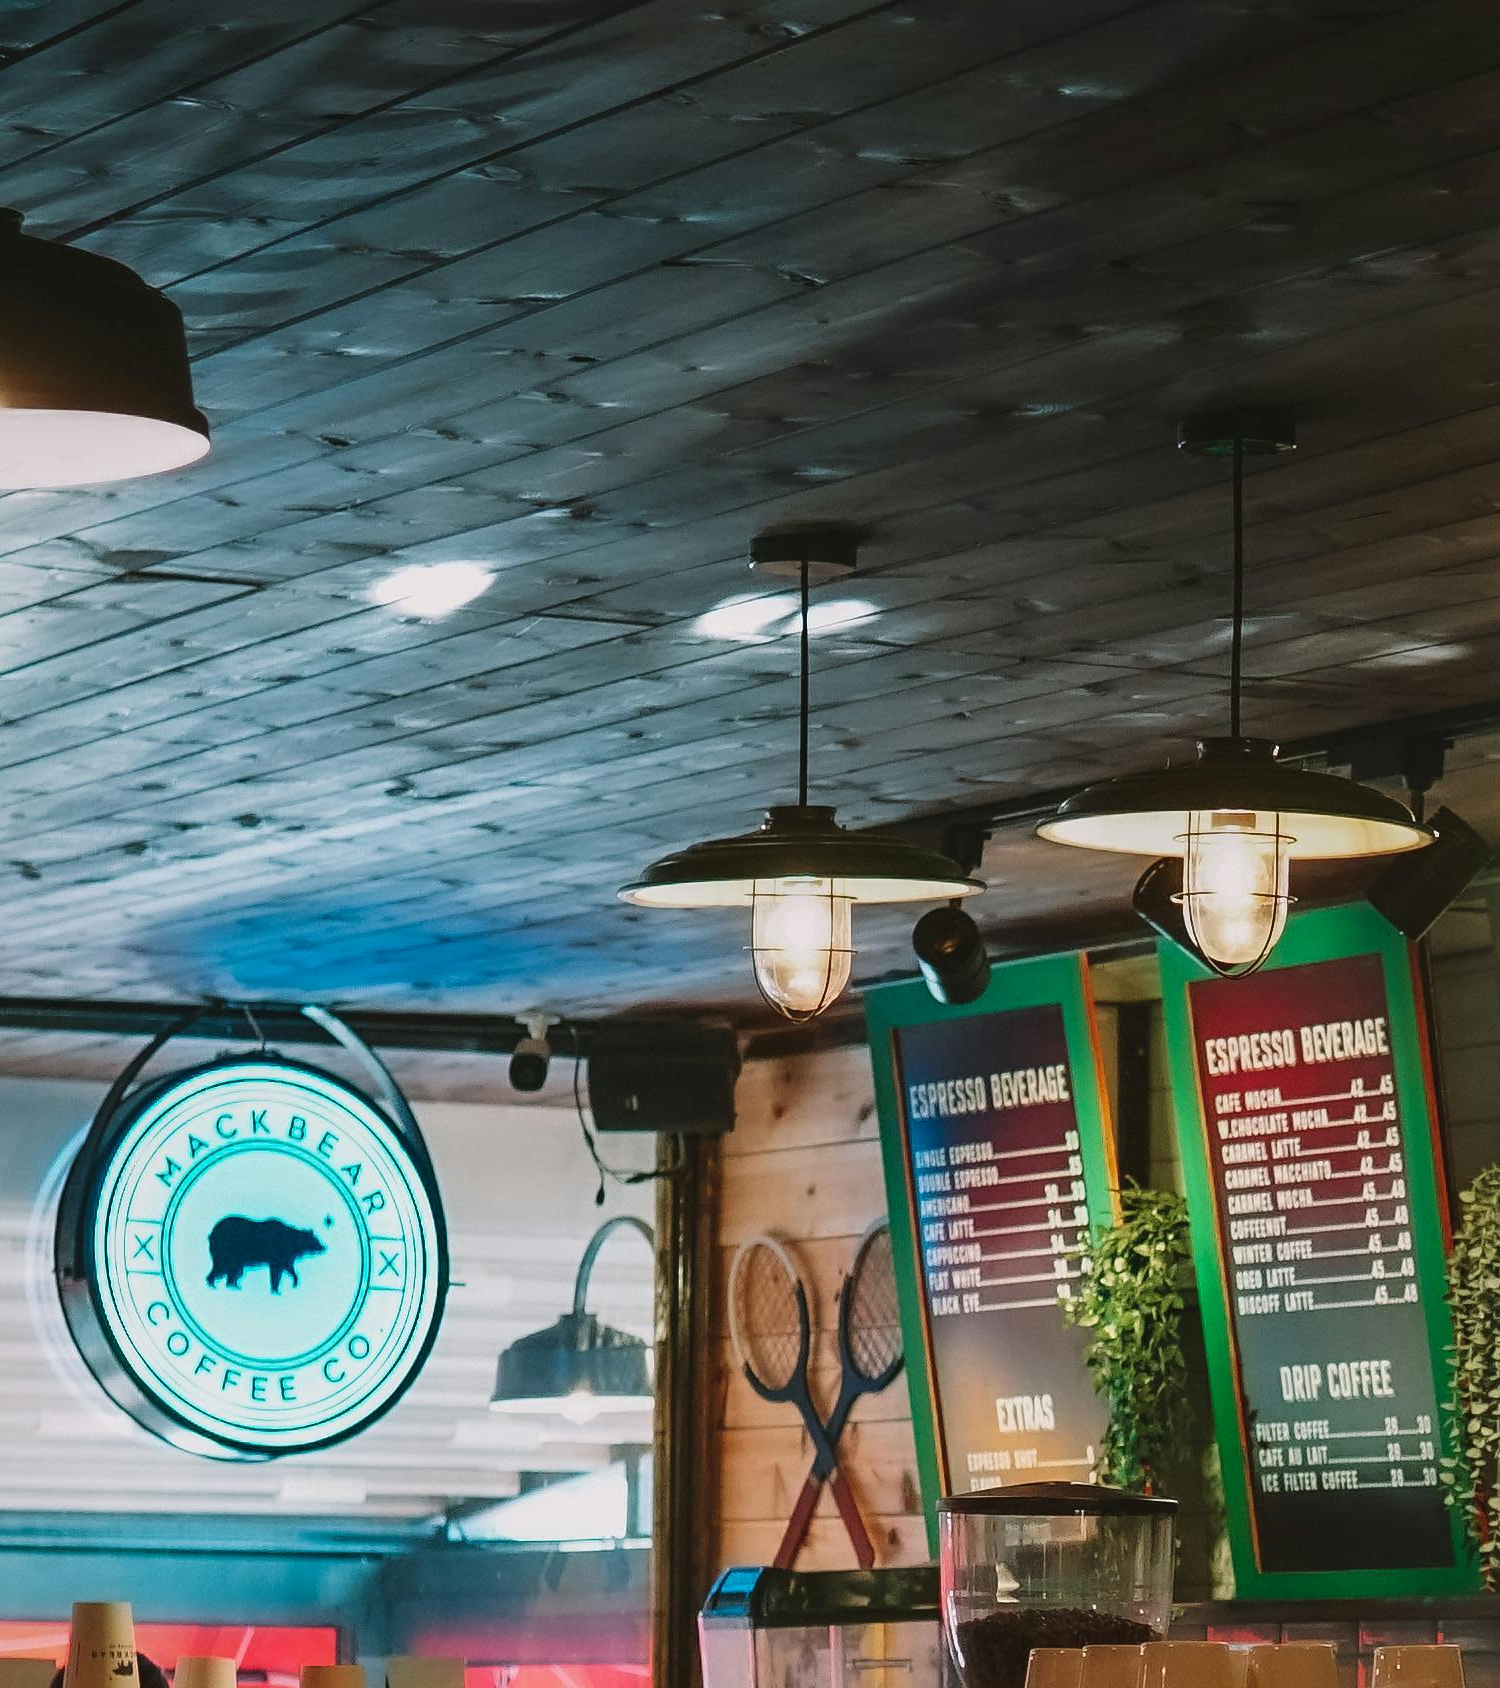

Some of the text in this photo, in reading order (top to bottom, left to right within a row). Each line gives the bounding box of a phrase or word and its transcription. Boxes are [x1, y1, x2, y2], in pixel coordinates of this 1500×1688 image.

[1205, 1017, 1389, 1077] ESPRESSO BEVERAGE
[909, 1064, 1070, 1120] ESPRESSO BEVERAGE
[156, 1109, 386, 1214] MACKBEAR
[1233, 1240, 1312, 1265] WINTER COFFEE
[147, 1301, 296, 1402] COFFEE
[1280, 1360, 1395, 1402] DRIP COFFEE
[996, 1394, 1055, 1433] EXTRAS
[1256, 1420, 1330, 1442] FILTER COFFEE
[1259, 1447, 1284, 1468] CAFE
[1307, 1446, 1328, 1465] LAIT
[1261, 1470, 1358, 1493] ICE FILTER COFFEE
